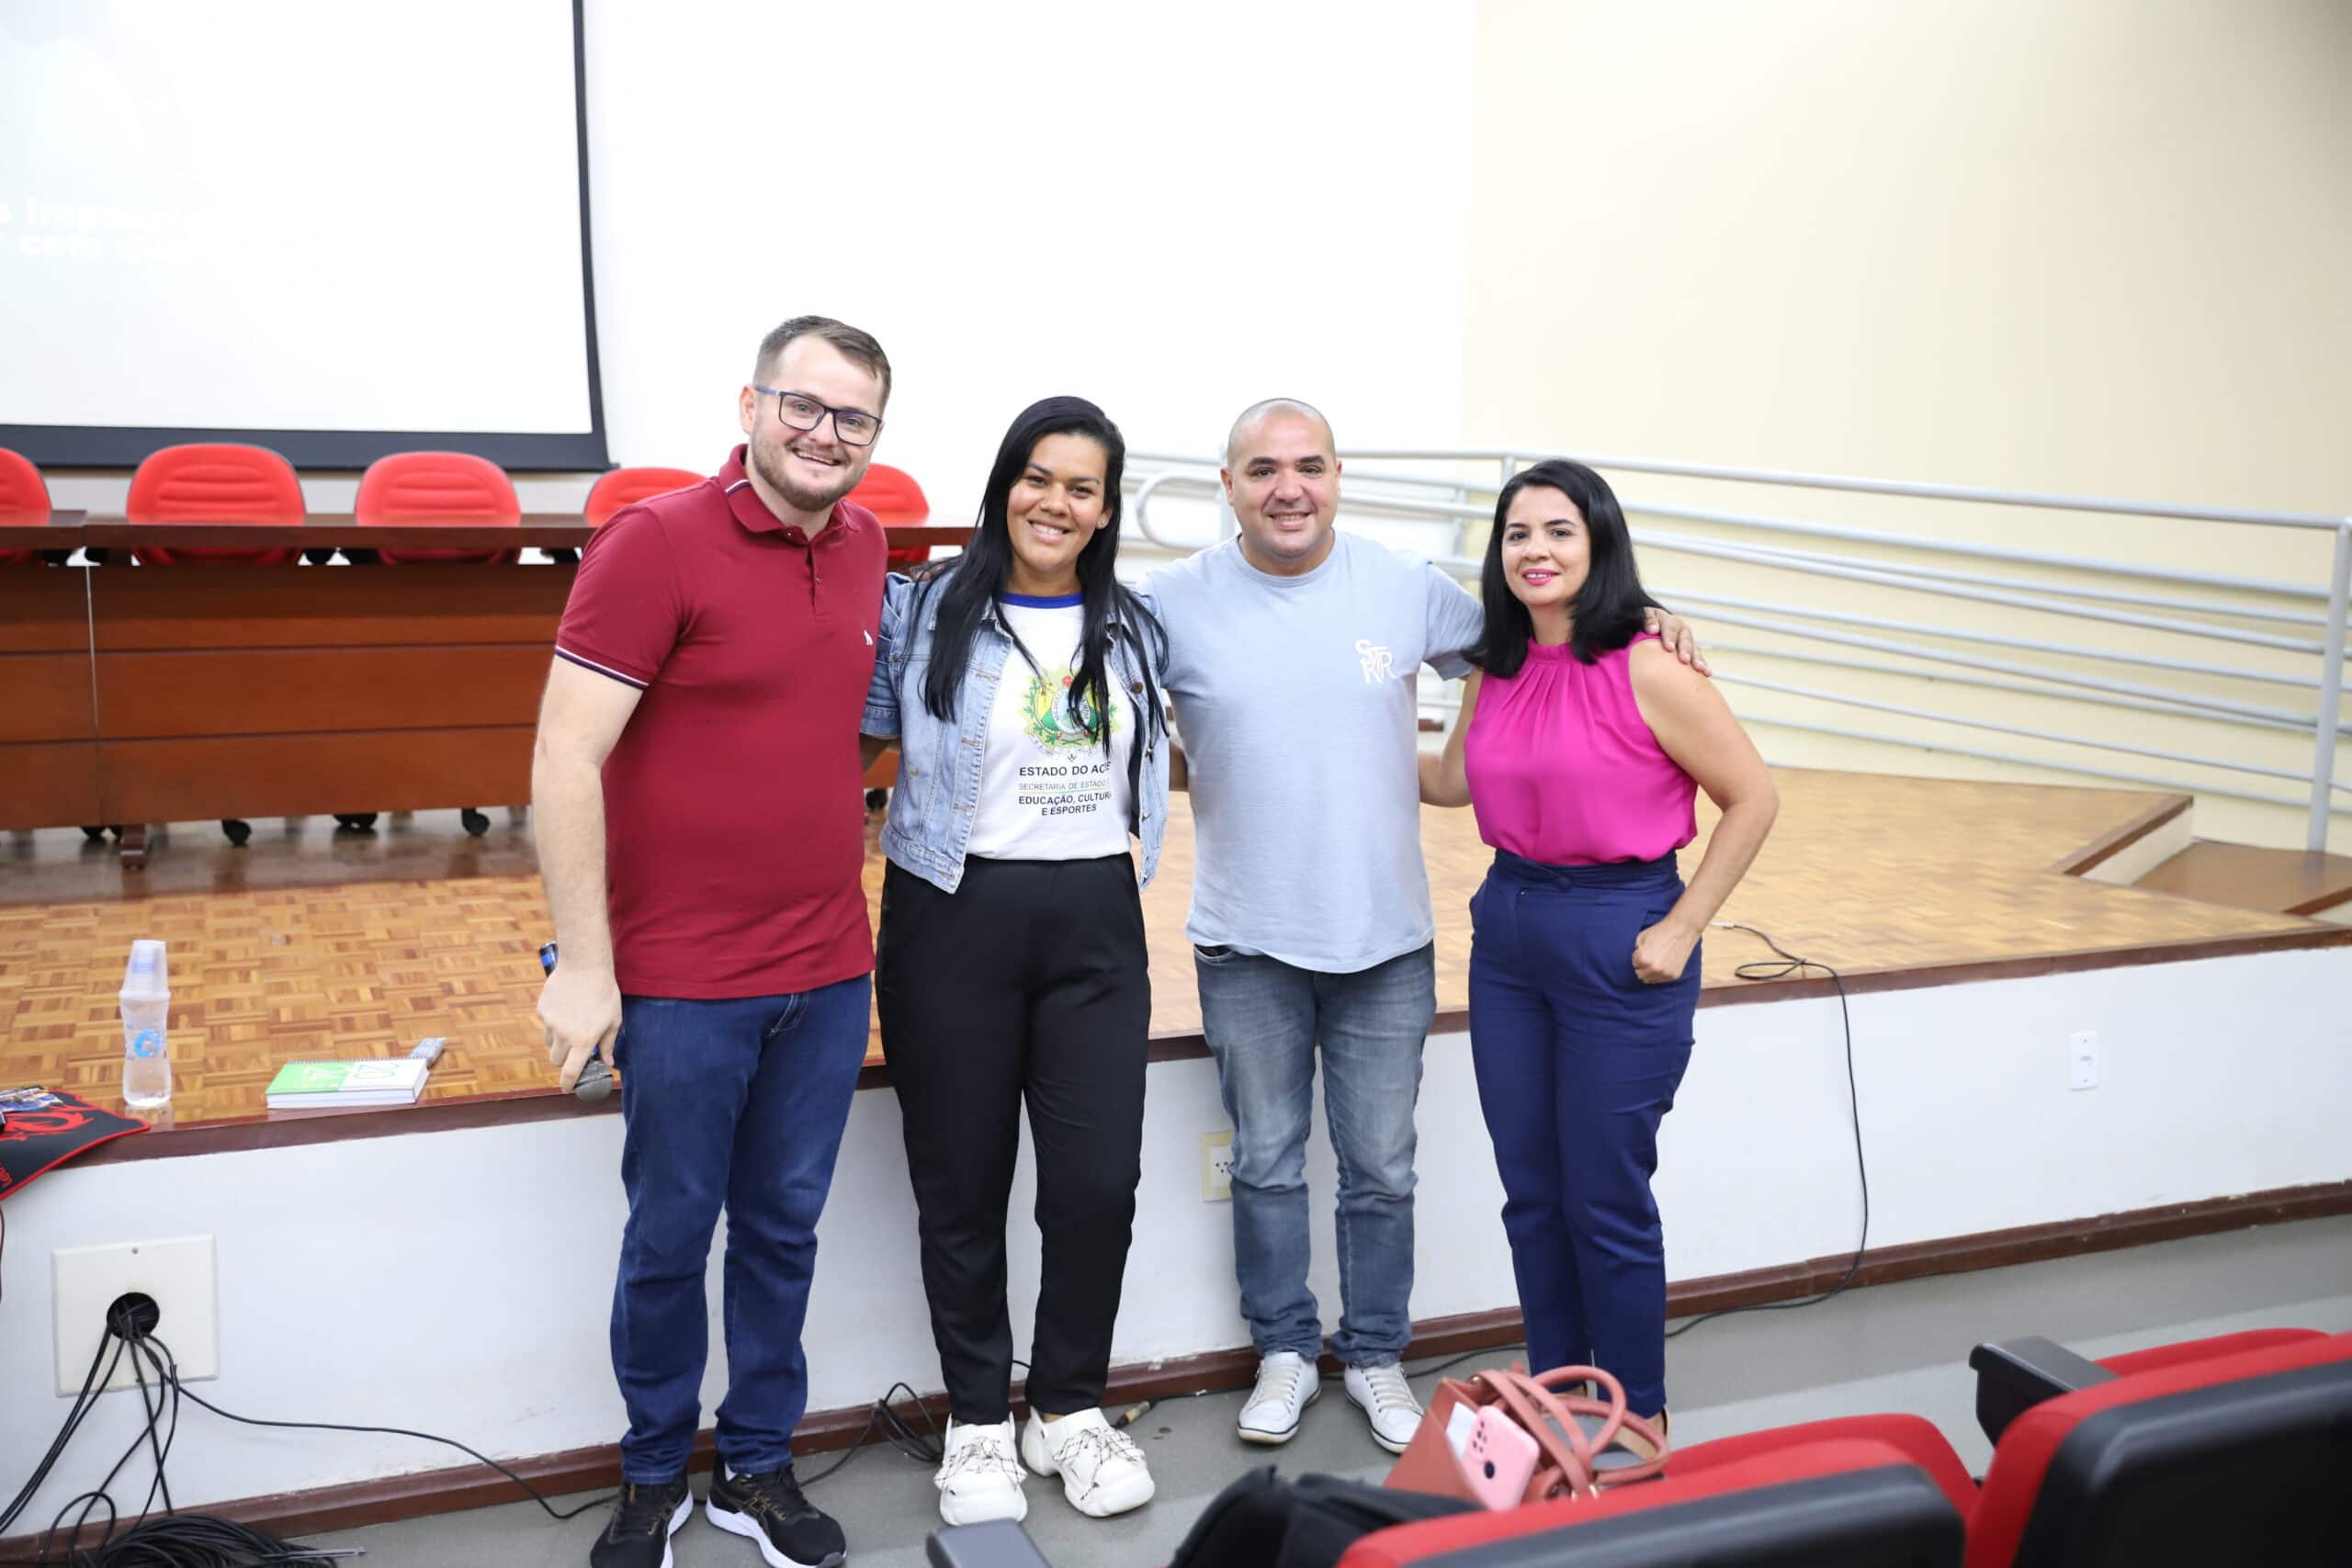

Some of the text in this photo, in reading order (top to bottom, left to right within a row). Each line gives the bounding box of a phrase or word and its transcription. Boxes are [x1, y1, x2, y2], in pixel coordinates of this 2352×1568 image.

[1019, 766, 1067, 776] ESTADO
[1072, 765, 1088, 775] DO
[1081, 779, 1106, 788] ESTADO
[1019, 792, 1111, 806] EDUCAÇÃO, CULTUR
[1042, 804, 1097, 816] E ESPORTES
